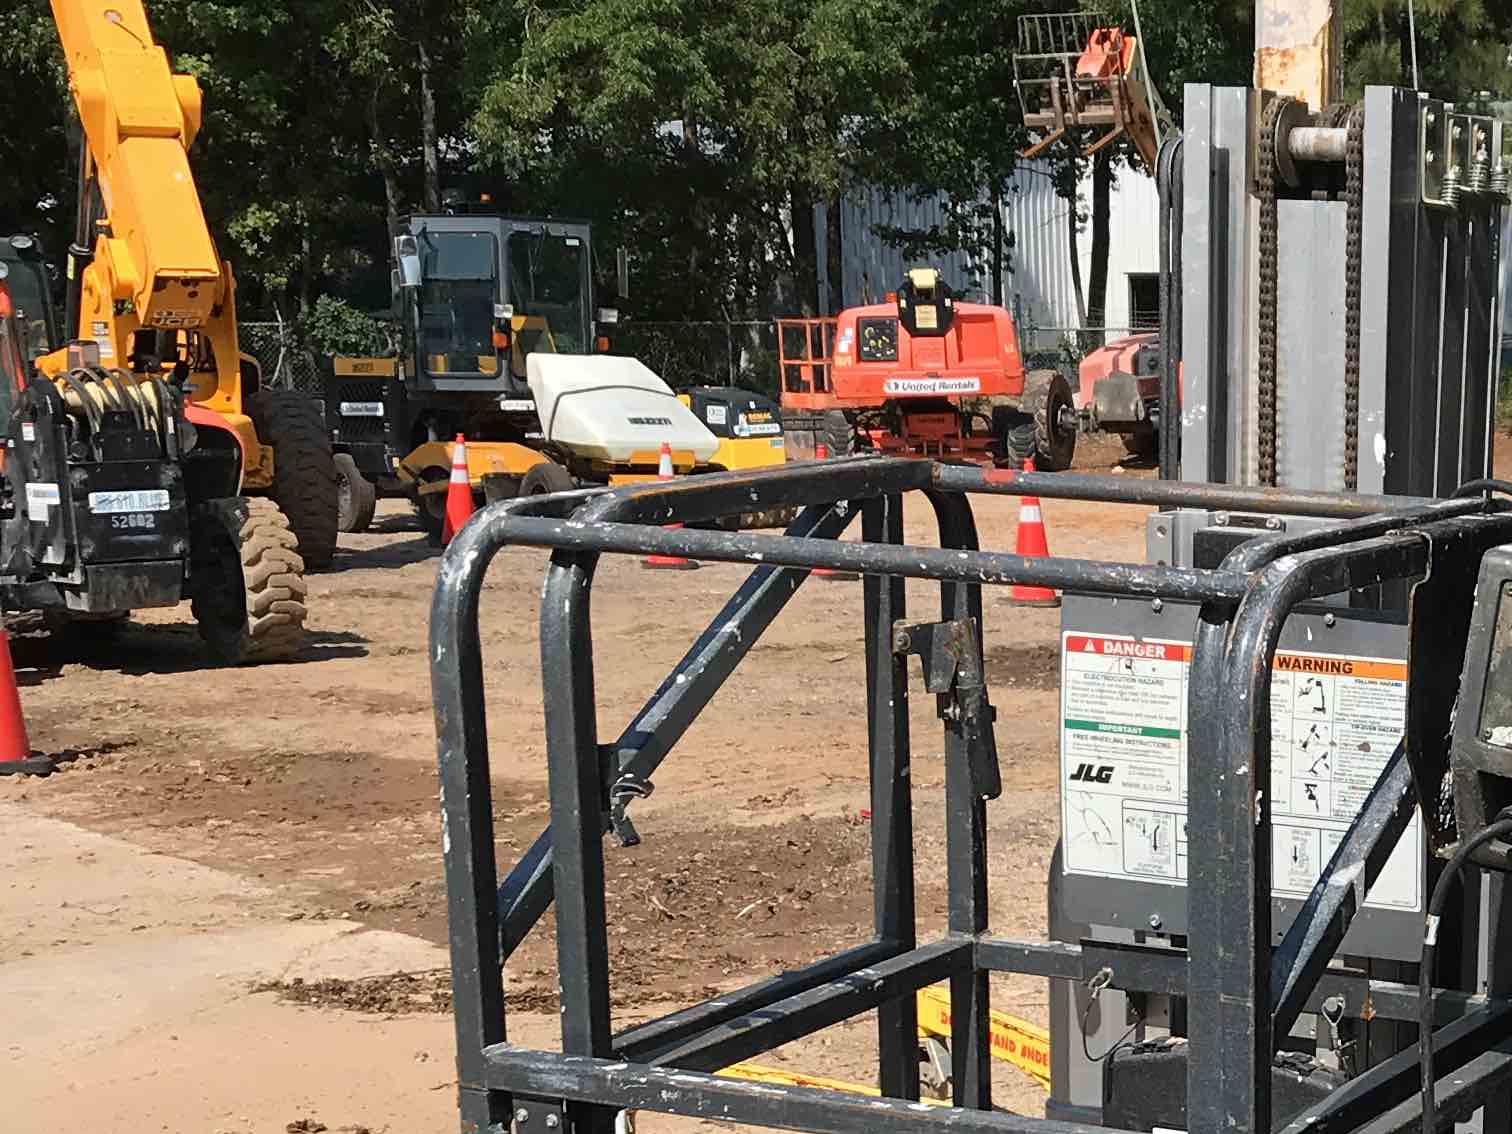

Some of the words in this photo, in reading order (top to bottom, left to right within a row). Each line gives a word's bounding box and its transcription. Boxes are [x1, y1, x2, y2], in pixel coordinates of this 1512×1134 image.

[901, 381, 937, 391] United
[938, 380, 976, 390] Rentals
[1103, 641, 1166, 659] DANGER
[1277, 655, 1353, 674] WARNING
[1069, 763, 1116, 784] JLG
